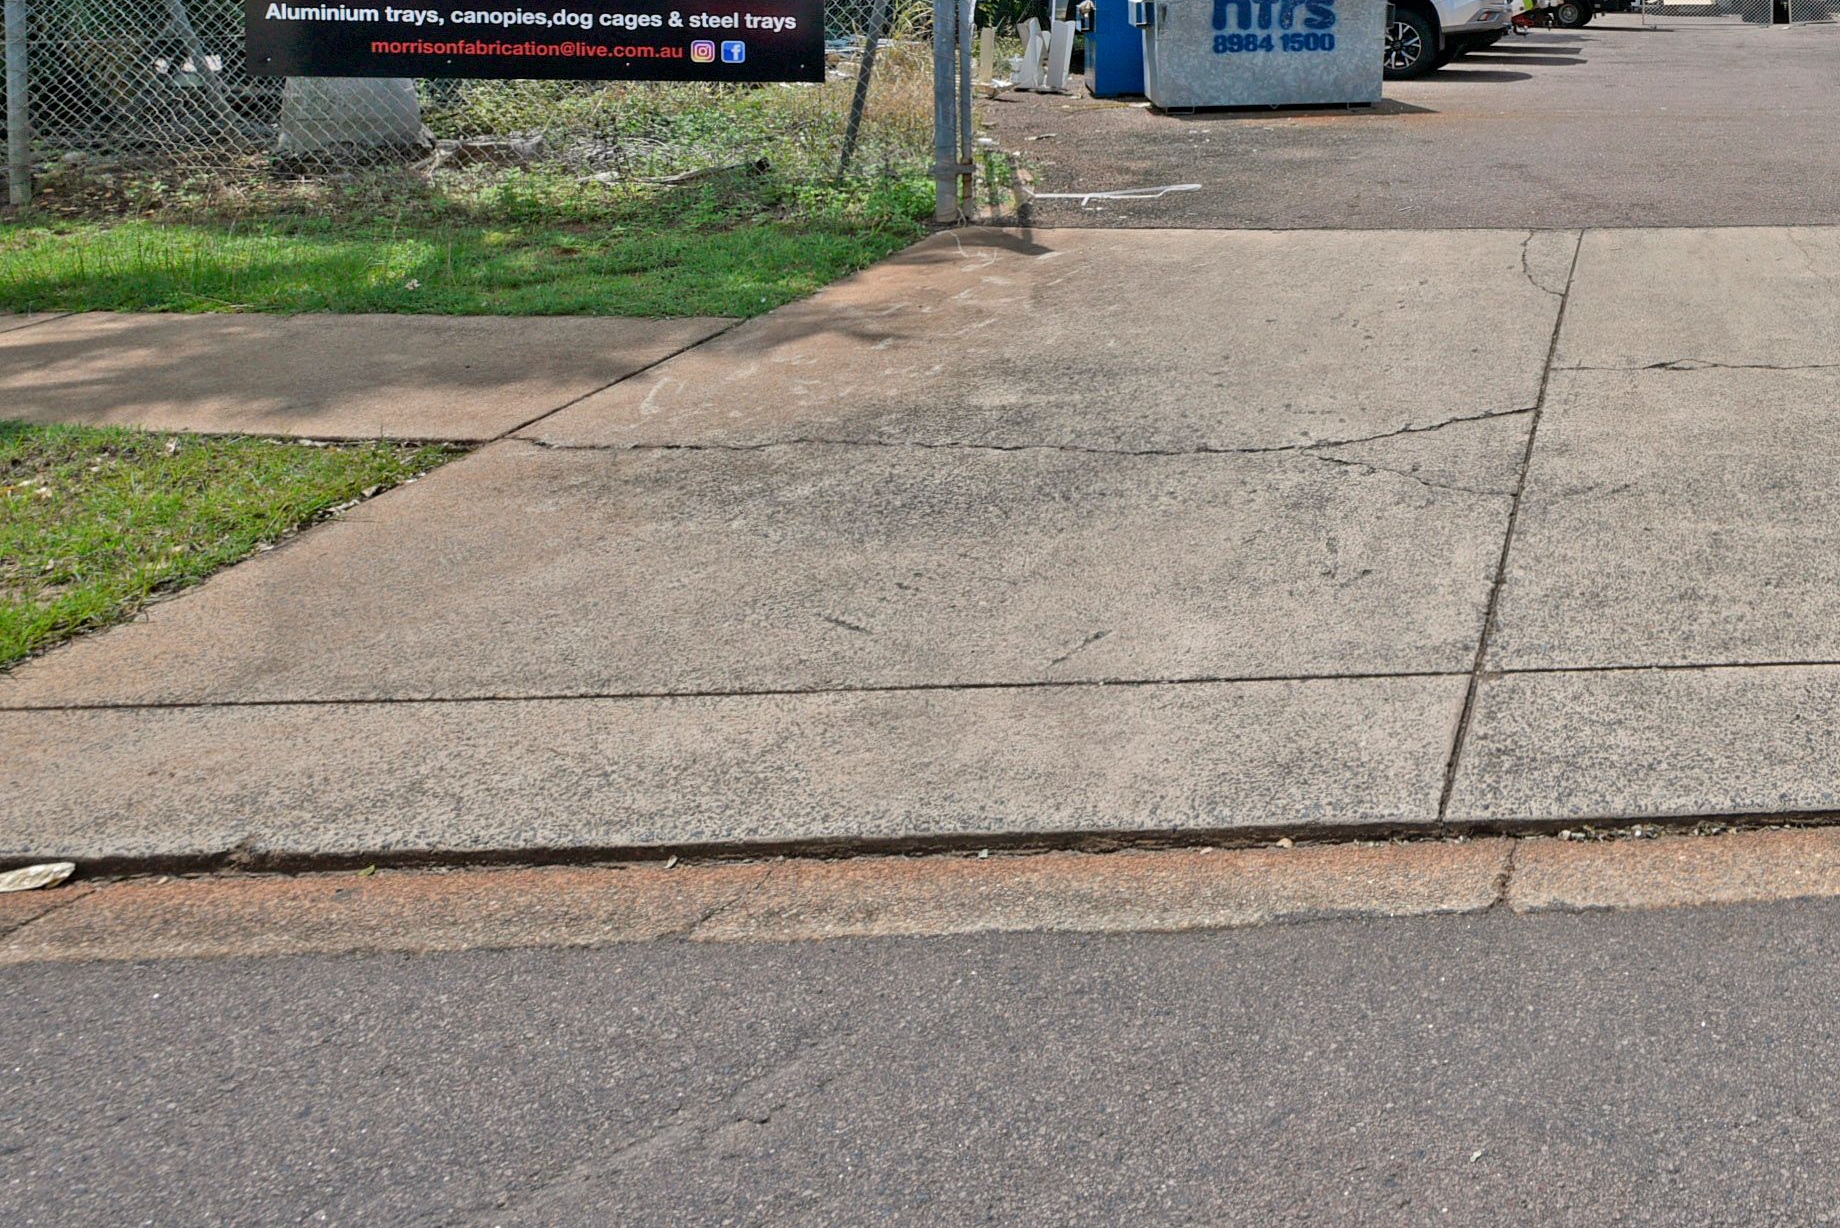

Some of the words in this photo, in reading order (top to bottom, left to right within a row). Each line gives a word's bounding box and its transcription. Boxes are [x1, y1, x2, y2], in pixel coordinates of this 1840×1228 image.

[265, 3, 379, 22] Aluminium
[385, 6, 445, 26] trays,
[599, 13, 662, 30] cages
[668, 11, 684, 28] &
[689, 12, 739, 29] steel
[745, 14, 797, 32] trays
[371, 39, 683, 59] morrisonfabrication@live.com.au
[1212, 33, 1274, 54] 8984
[1280, 32, 1335, 52] 1500
